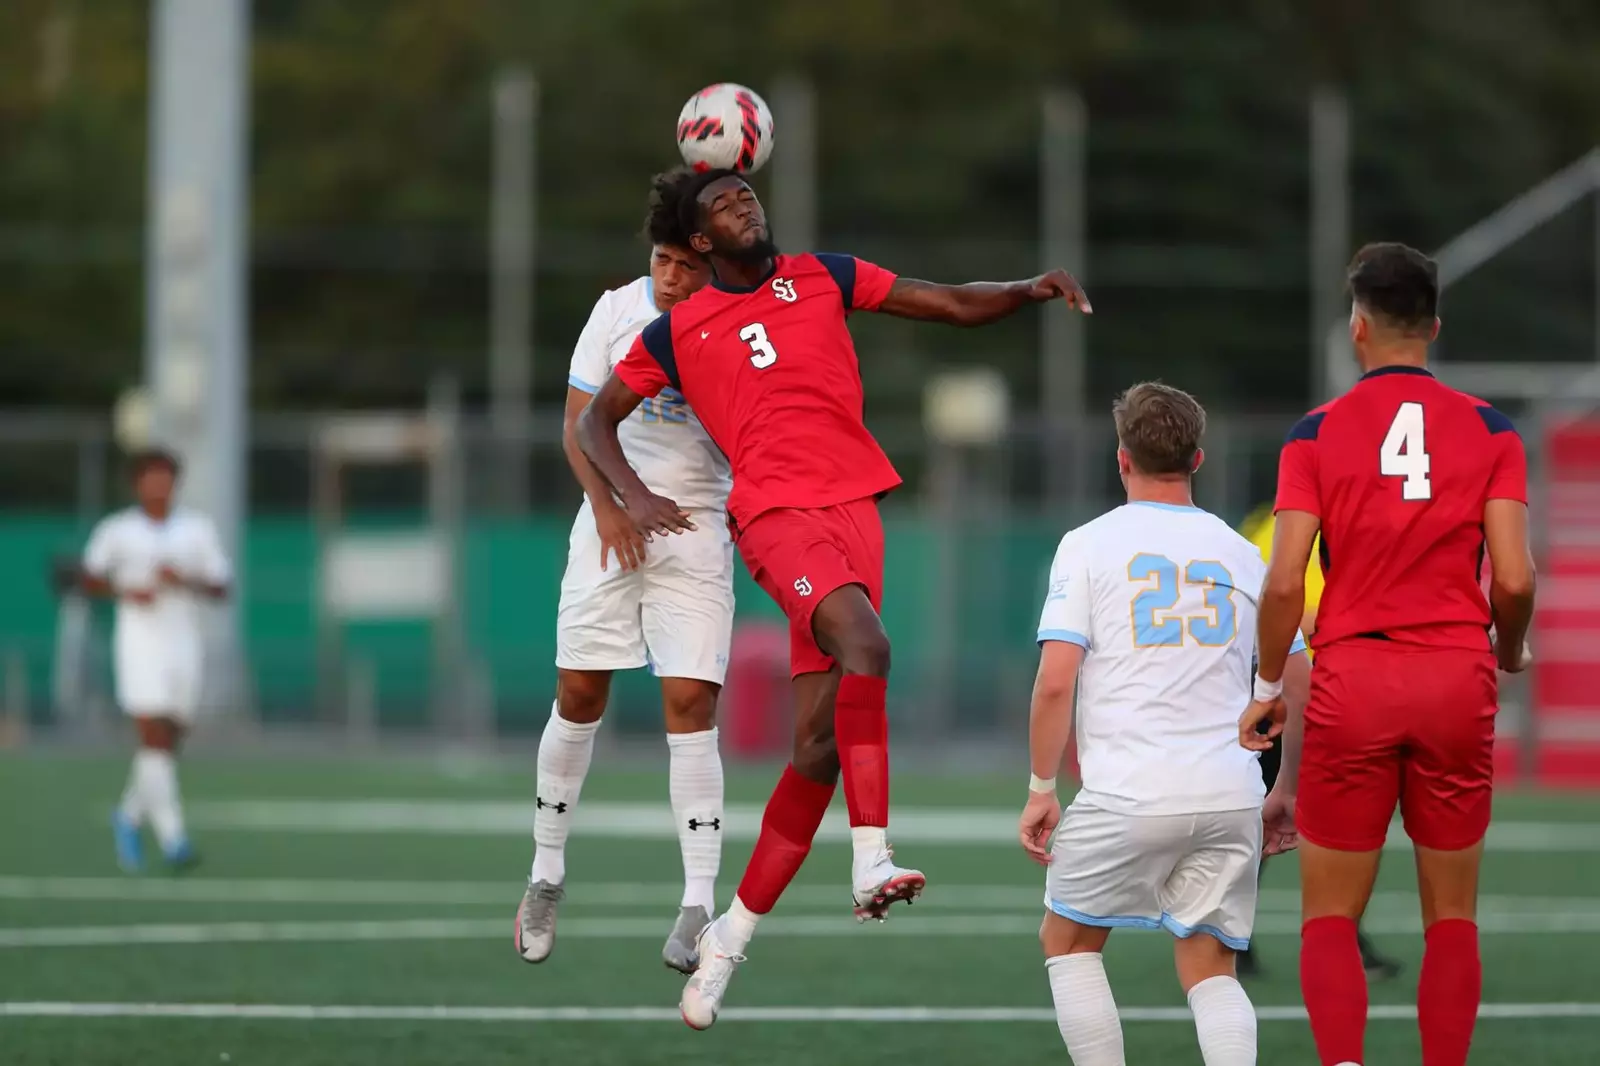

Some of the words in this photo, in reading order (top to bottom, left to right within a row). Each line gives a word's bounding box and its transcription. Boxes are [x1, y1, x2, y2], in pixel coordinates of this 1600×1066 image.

[738, 321, 778, 370] 3
[642, 386, 688, 424] 12
[1379, 401, 1432, 501] 4
[1127, 552, 1237, 649] 23
